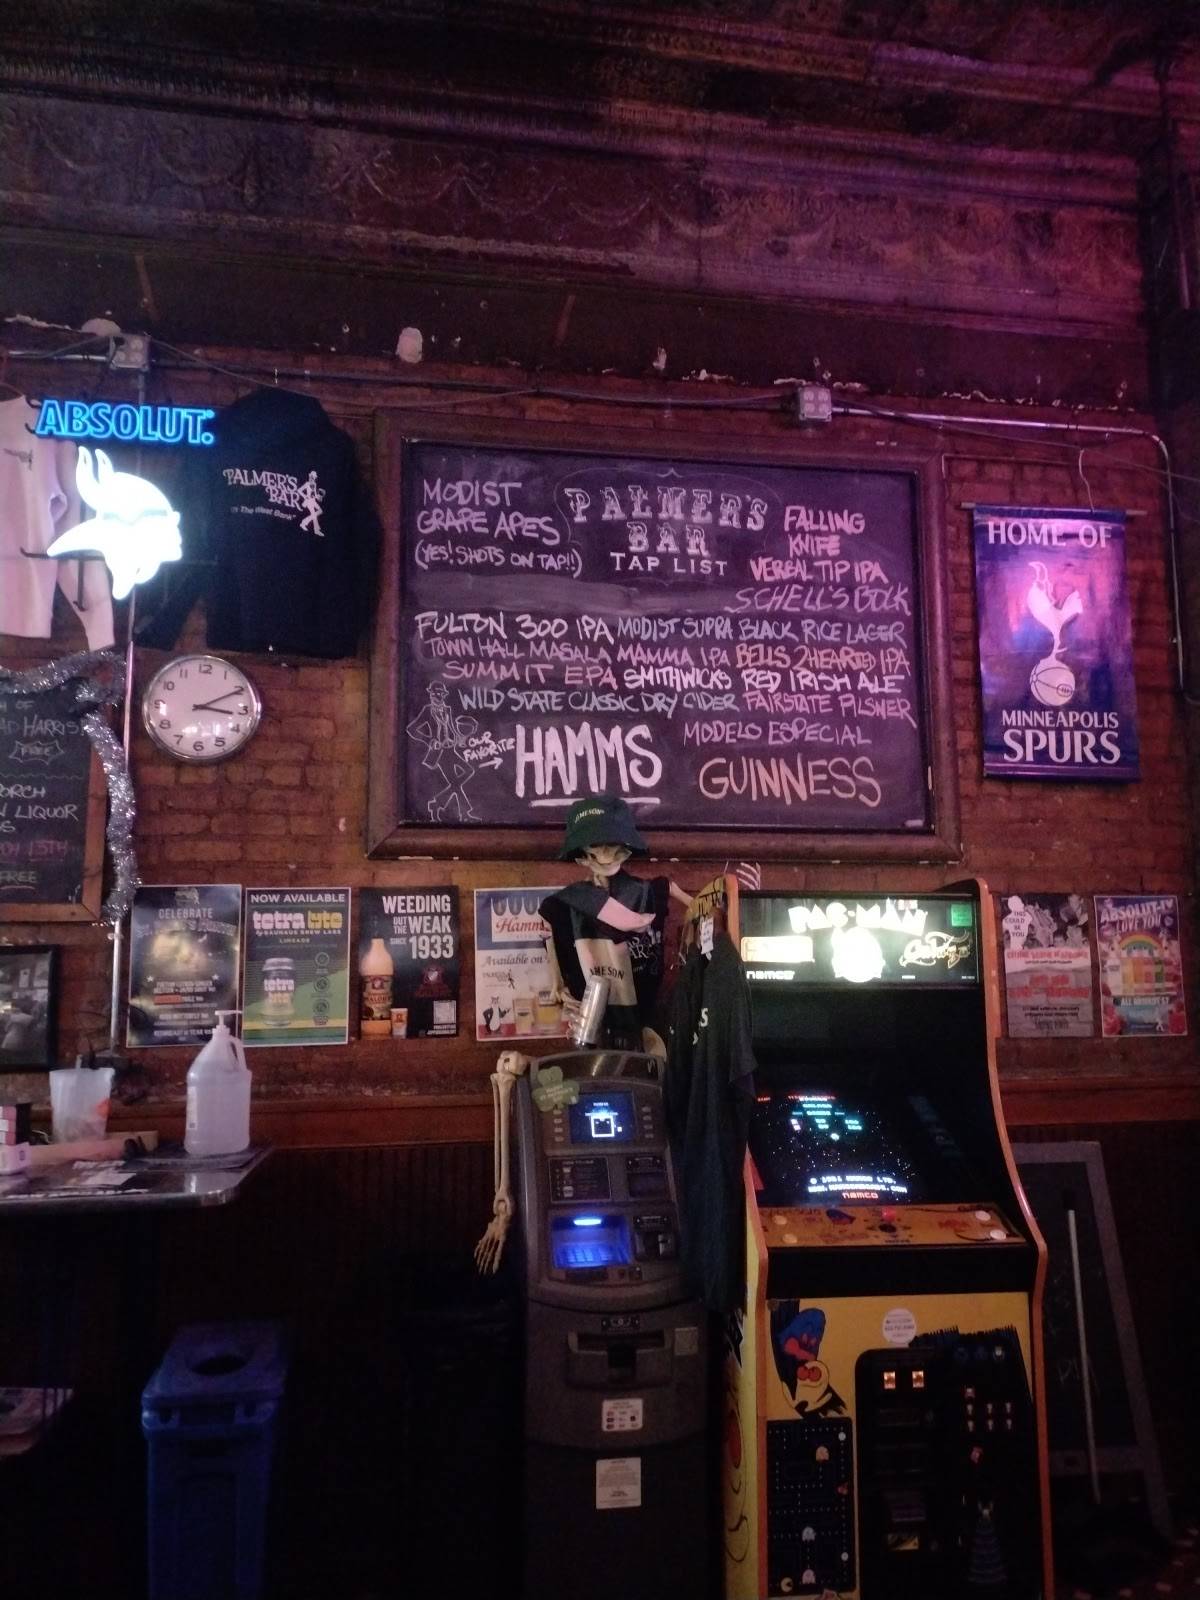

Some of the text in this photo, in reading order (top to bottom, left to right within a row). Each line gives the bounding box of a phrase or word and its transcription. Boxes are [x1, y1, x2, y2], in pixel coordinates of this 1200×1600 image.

[223, 468, 298, 492] PALMER'S
[423, 477, 522, 507] MODIST
[265, 487, 303, 511] BAR
[564, 484, 768, 531] PALMER'S
[417, 508, 560, 545] GRAPE APES
[784, 505, 866, 534] FALLING
[627, 521, 710, 557] BAR
[788, 533, 840, 557] KNIFE
[988, 521, 1113, 548] HOME OF
[457, 545, 505, 566] SHOTS
[511, 552, 533, 568] ON
[610, 551, 727, 576] TAP LIST
[750, 556, 889, 584] VERBAL TIP IPA
[724, 584, 850, 613] SCHELL'S
[415, 611, 907, 648] FULTON 300 IPA MODIST SUPRA BLACK RICE LAGER
[198, 663, 213, 674] 12
[424, 637, 474, 657] TOWN
[478, 637, 524, 660] HALL
[617, 642, 694, 666] MAMMA
[700, 647, 731, 668] IPA
[736, 643, 791, 669] BELLS
[880, 647, 911, 676] IPA
[163, 681, 175, 691] 10
[442, 661, 904, 694] SUMMIT EPA SMITHWICKS RED IRISH ALE
[238, 706, 249, 715] 3
[458, 687, 504, 711] WILD
[507, 688, 565, 712] STATE
[569, 691, 639, 712] CLASSIC
[640, 691, 678, 719] DRY
[683, 691, 740, 712] CIDER
[839, 693, 917, 729] PILSNER
[1002, 710, 1119, 729] MINNEAPOLIS
[159, 719, 171, 729] 8
[231, 724, 240, 733] 4
[683, 717, 872, 747] MODELO ESPECIAL
[173, 735, 183, 745] 7
[193, 741, 204, 751] 6
[214, 737, 226, 747] 5
[469, 731, 492, 748] OUR
[1003, 729, 1121, 764] SPURS
[516, 721, 662, 798] HAMMS
[700, 752, 881, 807] GUINNESS
[14, 804, 79, 822] LIQUOR
[251, 893, 345, 903] NOW AVAILABLE
[382, 895, 451, 914] WEEDING
[393, 916, 407, 925] OUT
[394, 925, 407, 934] THE
[408, 916, 452, 934] WEAK
[409, 936, 454, 959] 1933
[482, 954, 529, 967] Available
[531, 956, 543, 964] on
